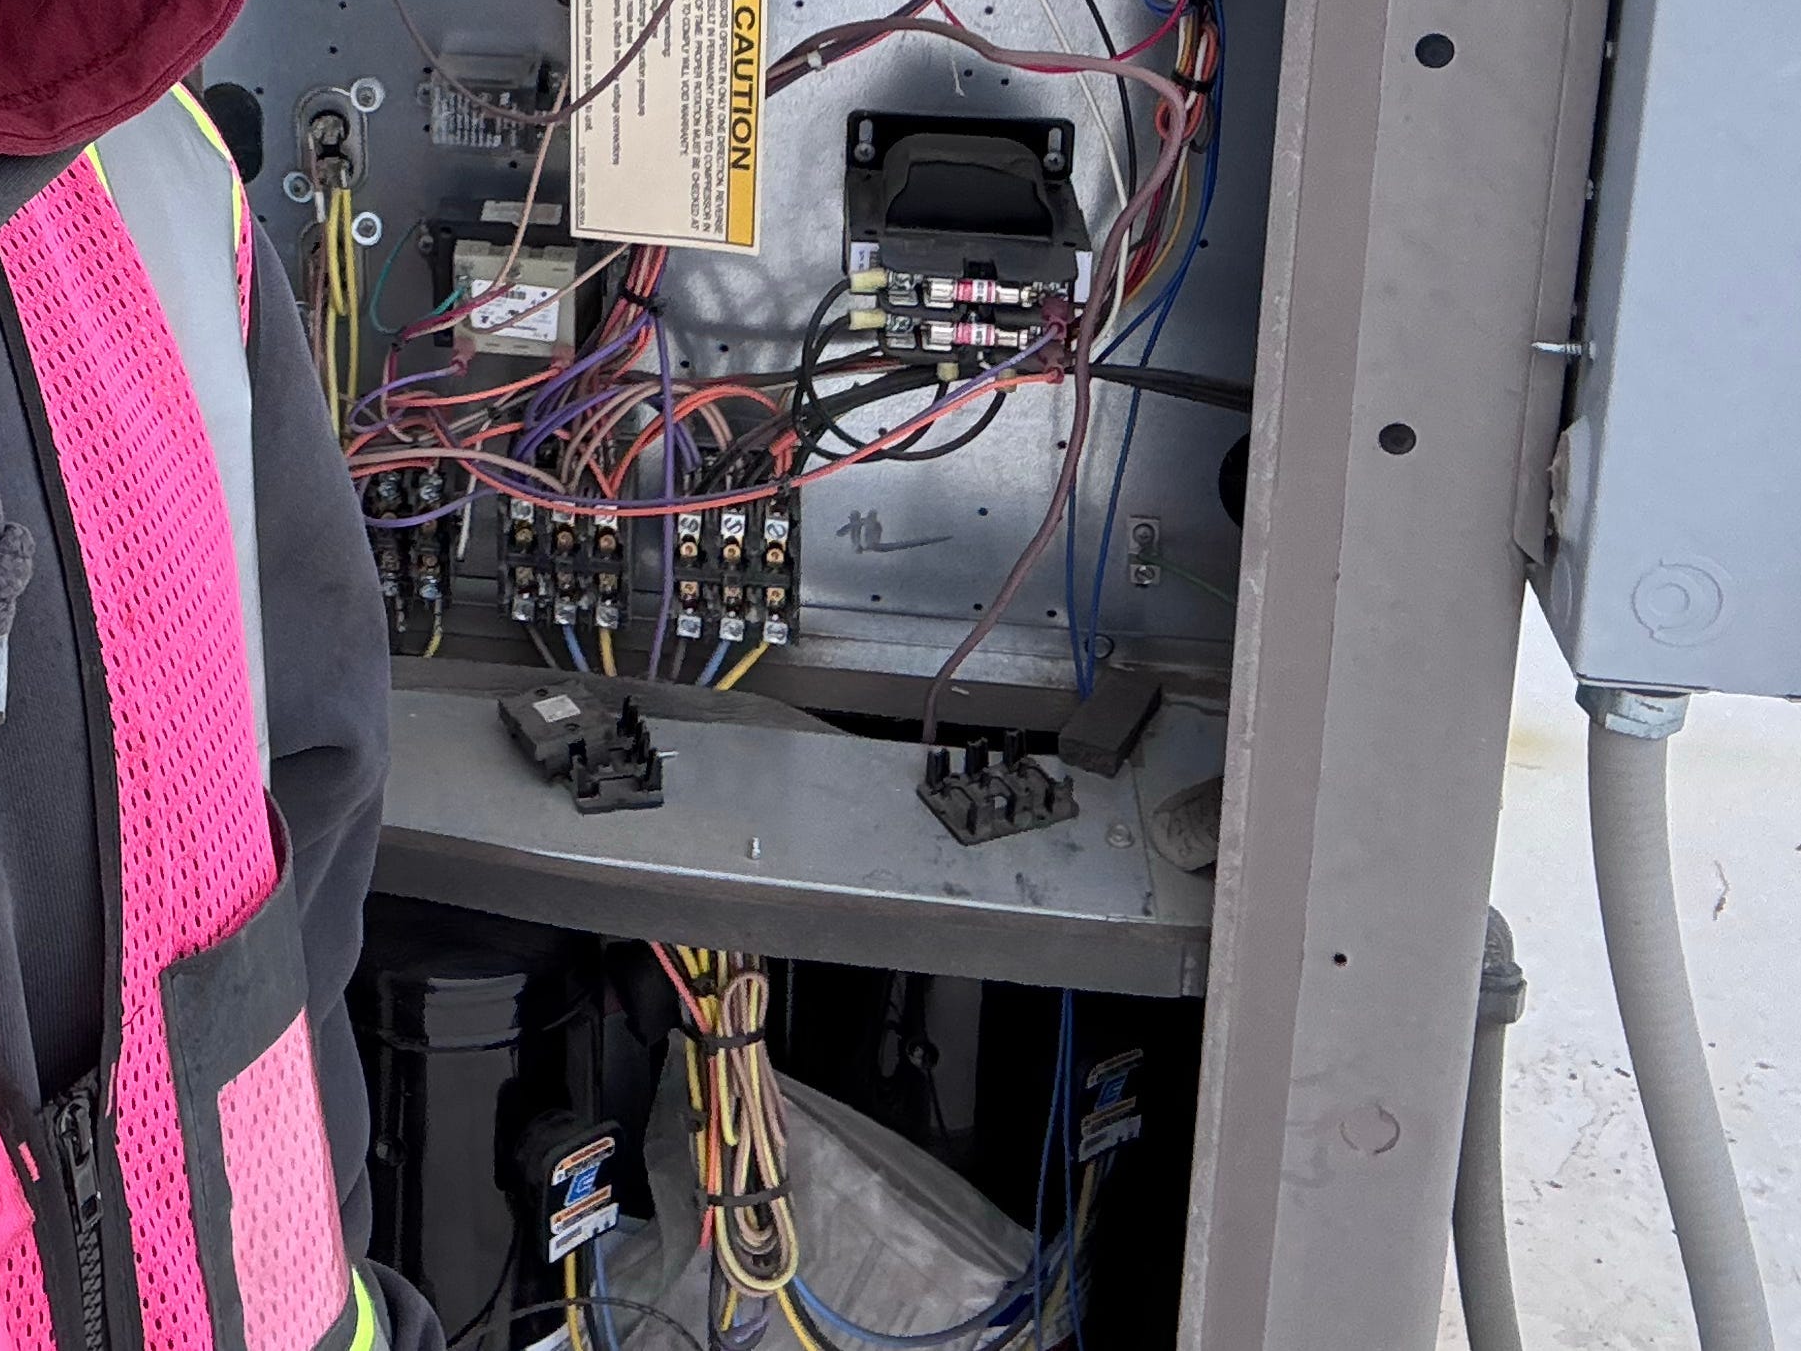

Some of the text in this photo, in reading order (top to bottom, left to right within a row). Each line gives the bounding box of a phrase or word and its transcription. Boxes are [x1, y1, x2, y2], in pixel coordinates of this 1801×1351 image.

[682, 2, 690, 14] TO
[681, 17, 690, 53] COMPLY
[707, 27, 714, 36] IN
[694, 40, 702, 78] PROPER
[718, 30, 727, 73] OPERATE
[681, 57, 689, 77] WILL
[705, 39, 714, 95] PERMANENT
[718, 75, 726, 84] IN
[681, 80, 689, 101] VOID
[717, 86, 726, 111] ONLY
[730, 6, 755, 170] CAUTION
[693, 80, 701, 126] ROTATION
[704, 98, 713, 136] DAMAGE
[717, 113, 725, 133] ONE
[692, 129, 700, 154] MUST
[704, 139, 712, 152] TO
[692, 156, 699, 169] BE
[691, 172, 699, 216] CHECKED
[702, 154, 712, 220] COMPRESSOR
[690, 217, 698, 230] AT
[714, 189, 723, 234] REVERSE
[702, 222, 710, 232] IN
